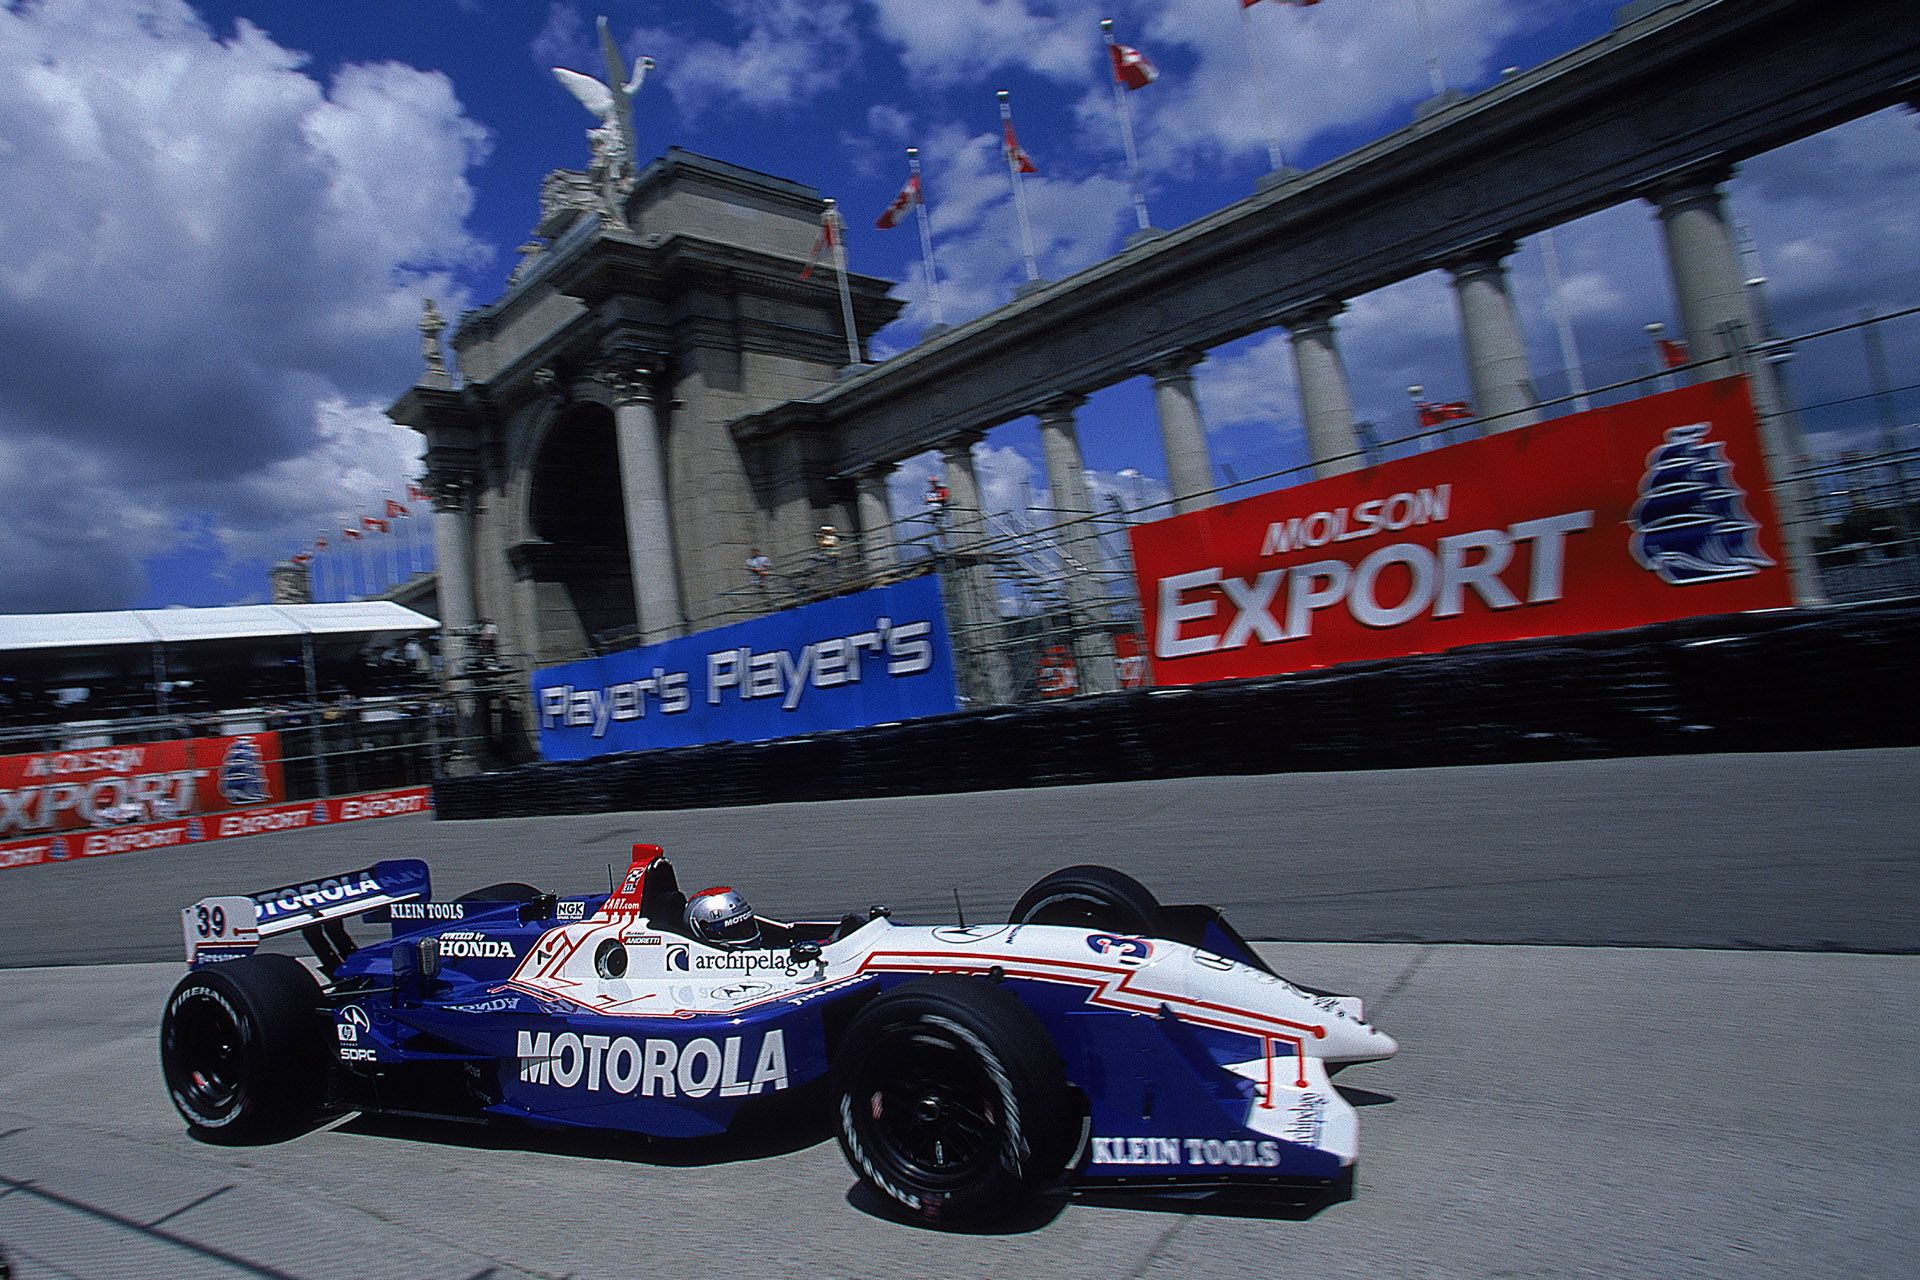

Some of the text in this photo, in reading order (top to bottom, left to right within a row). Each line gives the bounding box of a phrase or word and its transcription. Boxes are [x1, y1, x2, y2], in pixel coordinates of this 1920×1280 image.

[1260, 484, 1452, 556] MOLSON
[1155, 509, 1595, 659] EXPORT
[540, 617, 931, 737] Player's Player's
[197, 905, 225, 938] 39
[390, 903, 464, 920] KLEIN TOOLS
[559, 902, 583, 915] NGK
[439, 941, 516, 958] HONDA
[625, 937, 660, 945] ANDRETTI
[695, 948, 809, 977] archipelago
[517, 1029, 789, 1098] MOTOROLA
[1092, 1137, 1281, 1167] KLEIN TOOLS
